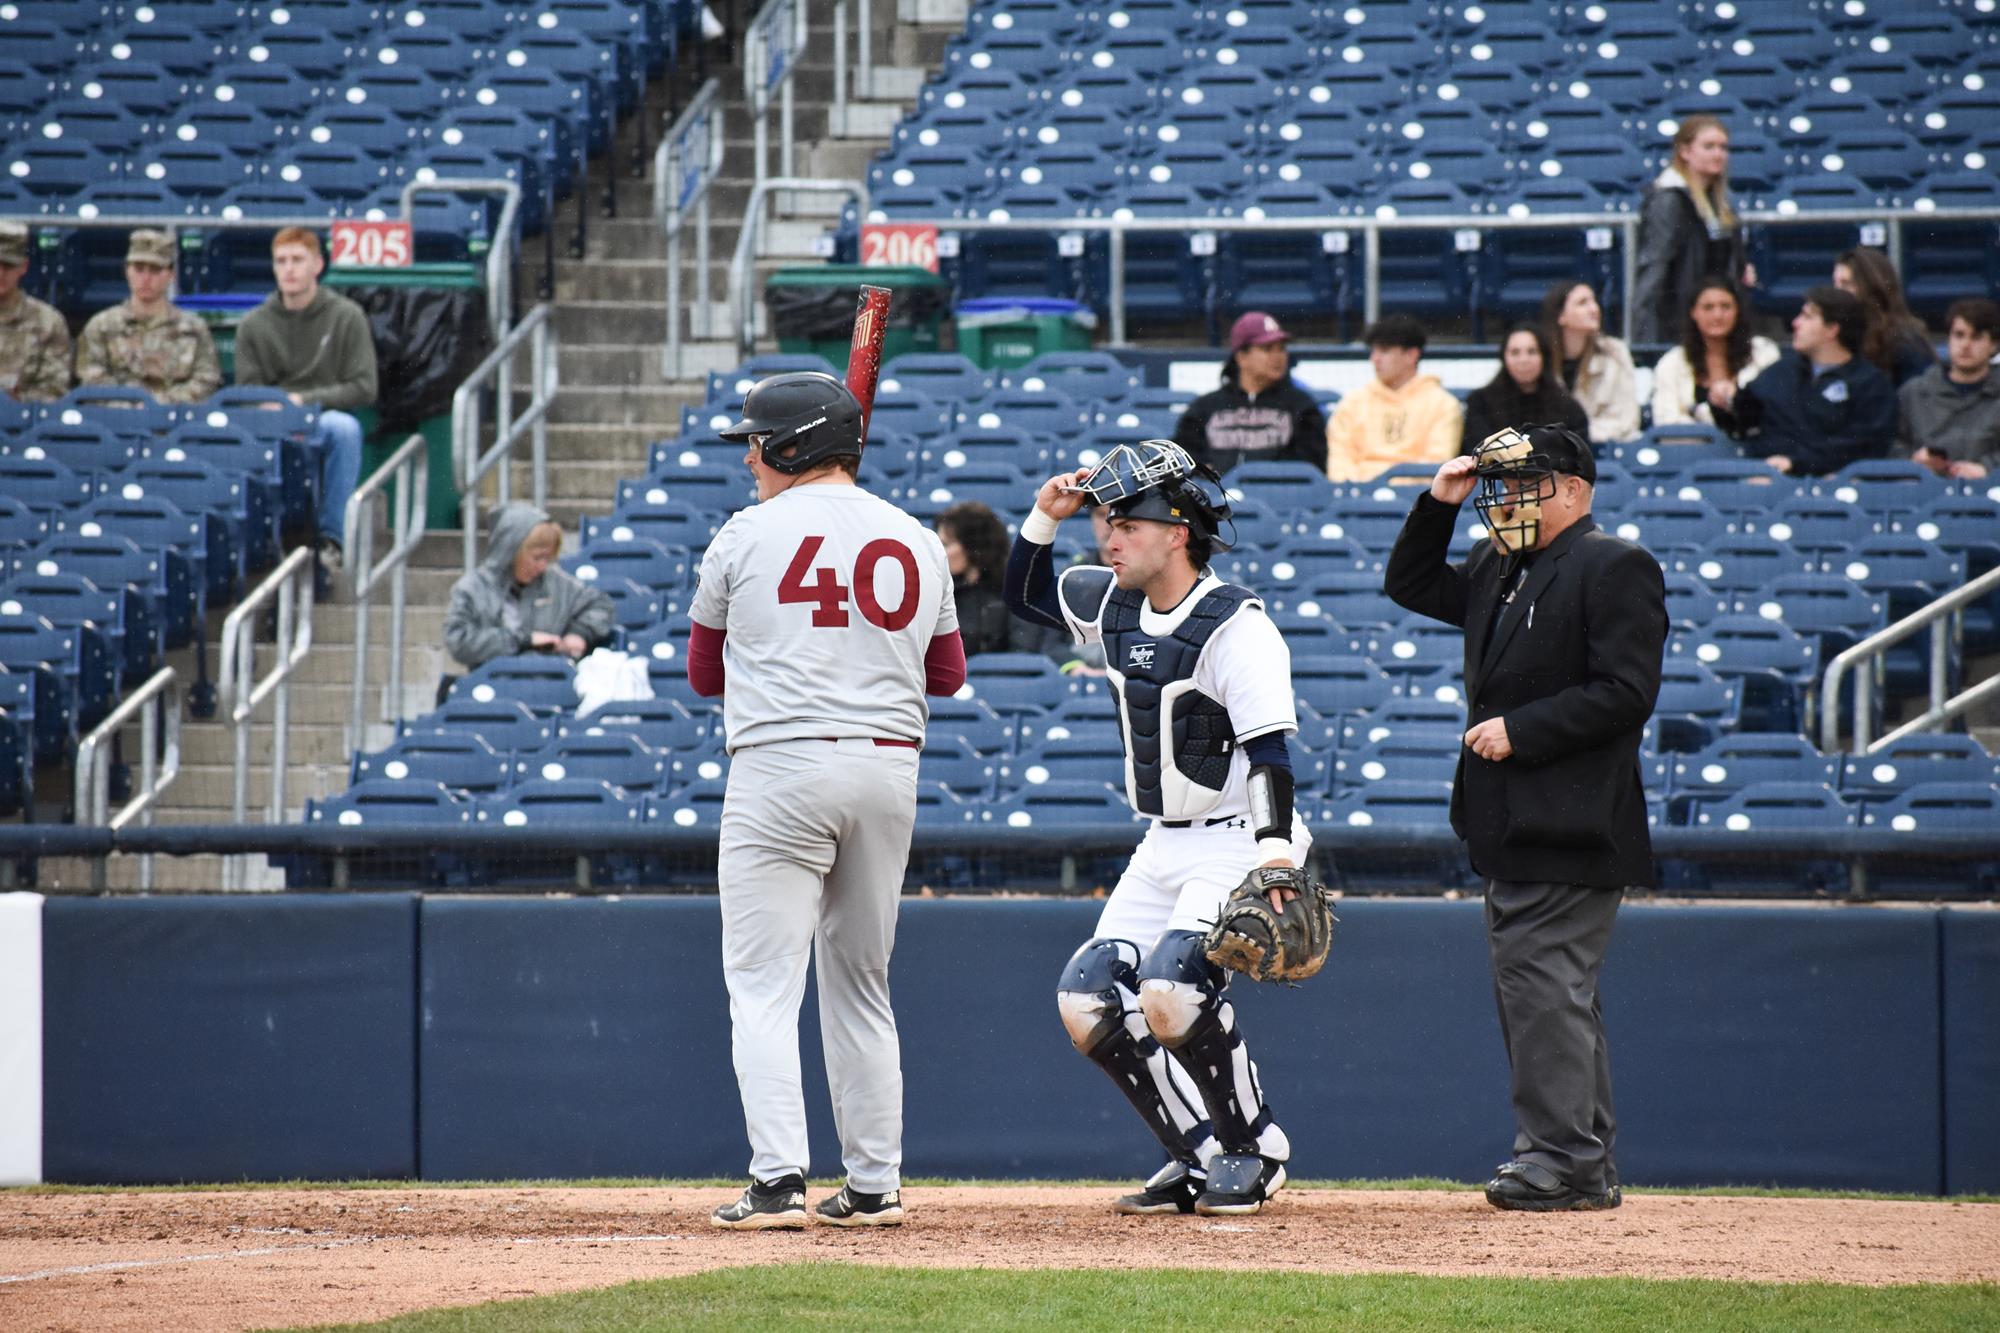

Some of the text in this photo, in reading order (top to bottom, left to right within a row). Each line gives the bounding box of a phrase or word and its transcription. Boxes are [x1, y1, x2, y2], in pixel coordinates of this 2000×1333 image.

[334, 227, 408, 267] 205
[863, 230, 934, 269] 206
[777, 536, 920, 632] 40
